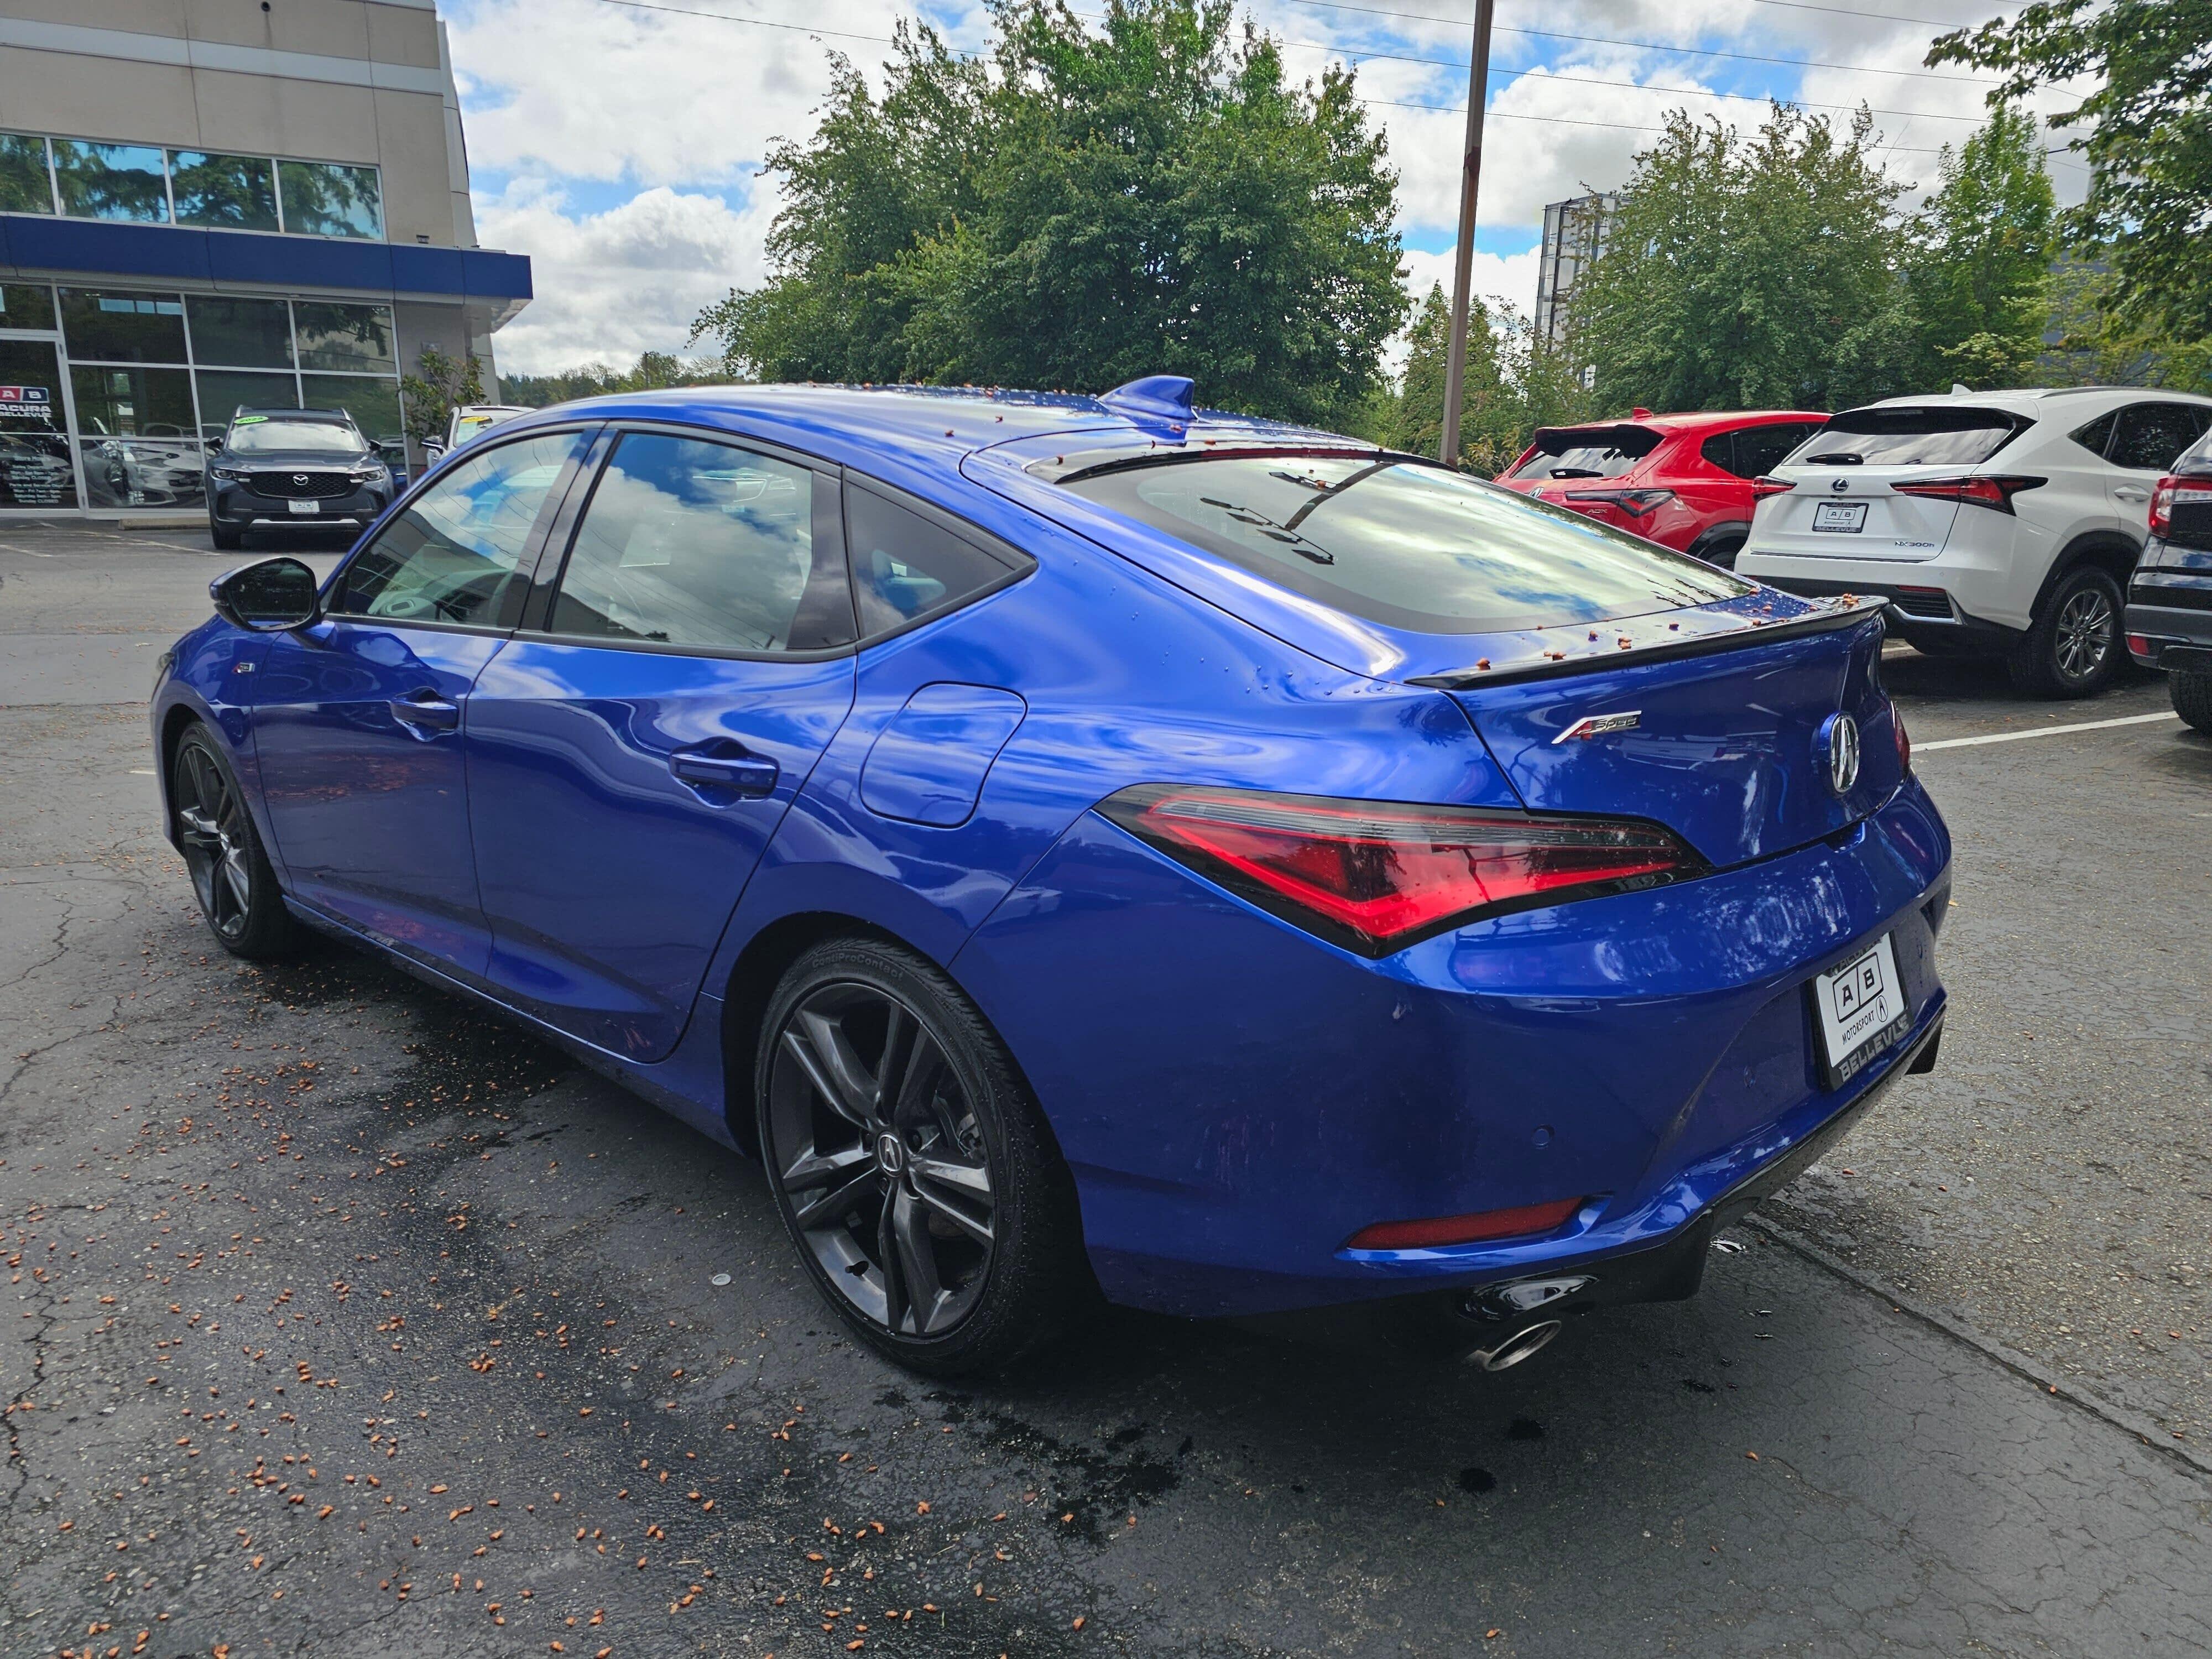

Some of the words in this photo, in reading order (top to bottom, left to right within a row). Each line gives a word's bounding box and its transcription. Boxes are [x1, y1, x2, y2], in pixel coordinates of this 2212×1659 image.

[0, 404, 52, 412] ACURA
[2, 390, 15, 398] A
[1842, 984, 1853, 1008] A
[1863, 968, 1875, 990] B
[1842, 1010, 1876, 1045] MOTORSPORT
[1839, 1013, 1908, 1083] BELLEVUE
